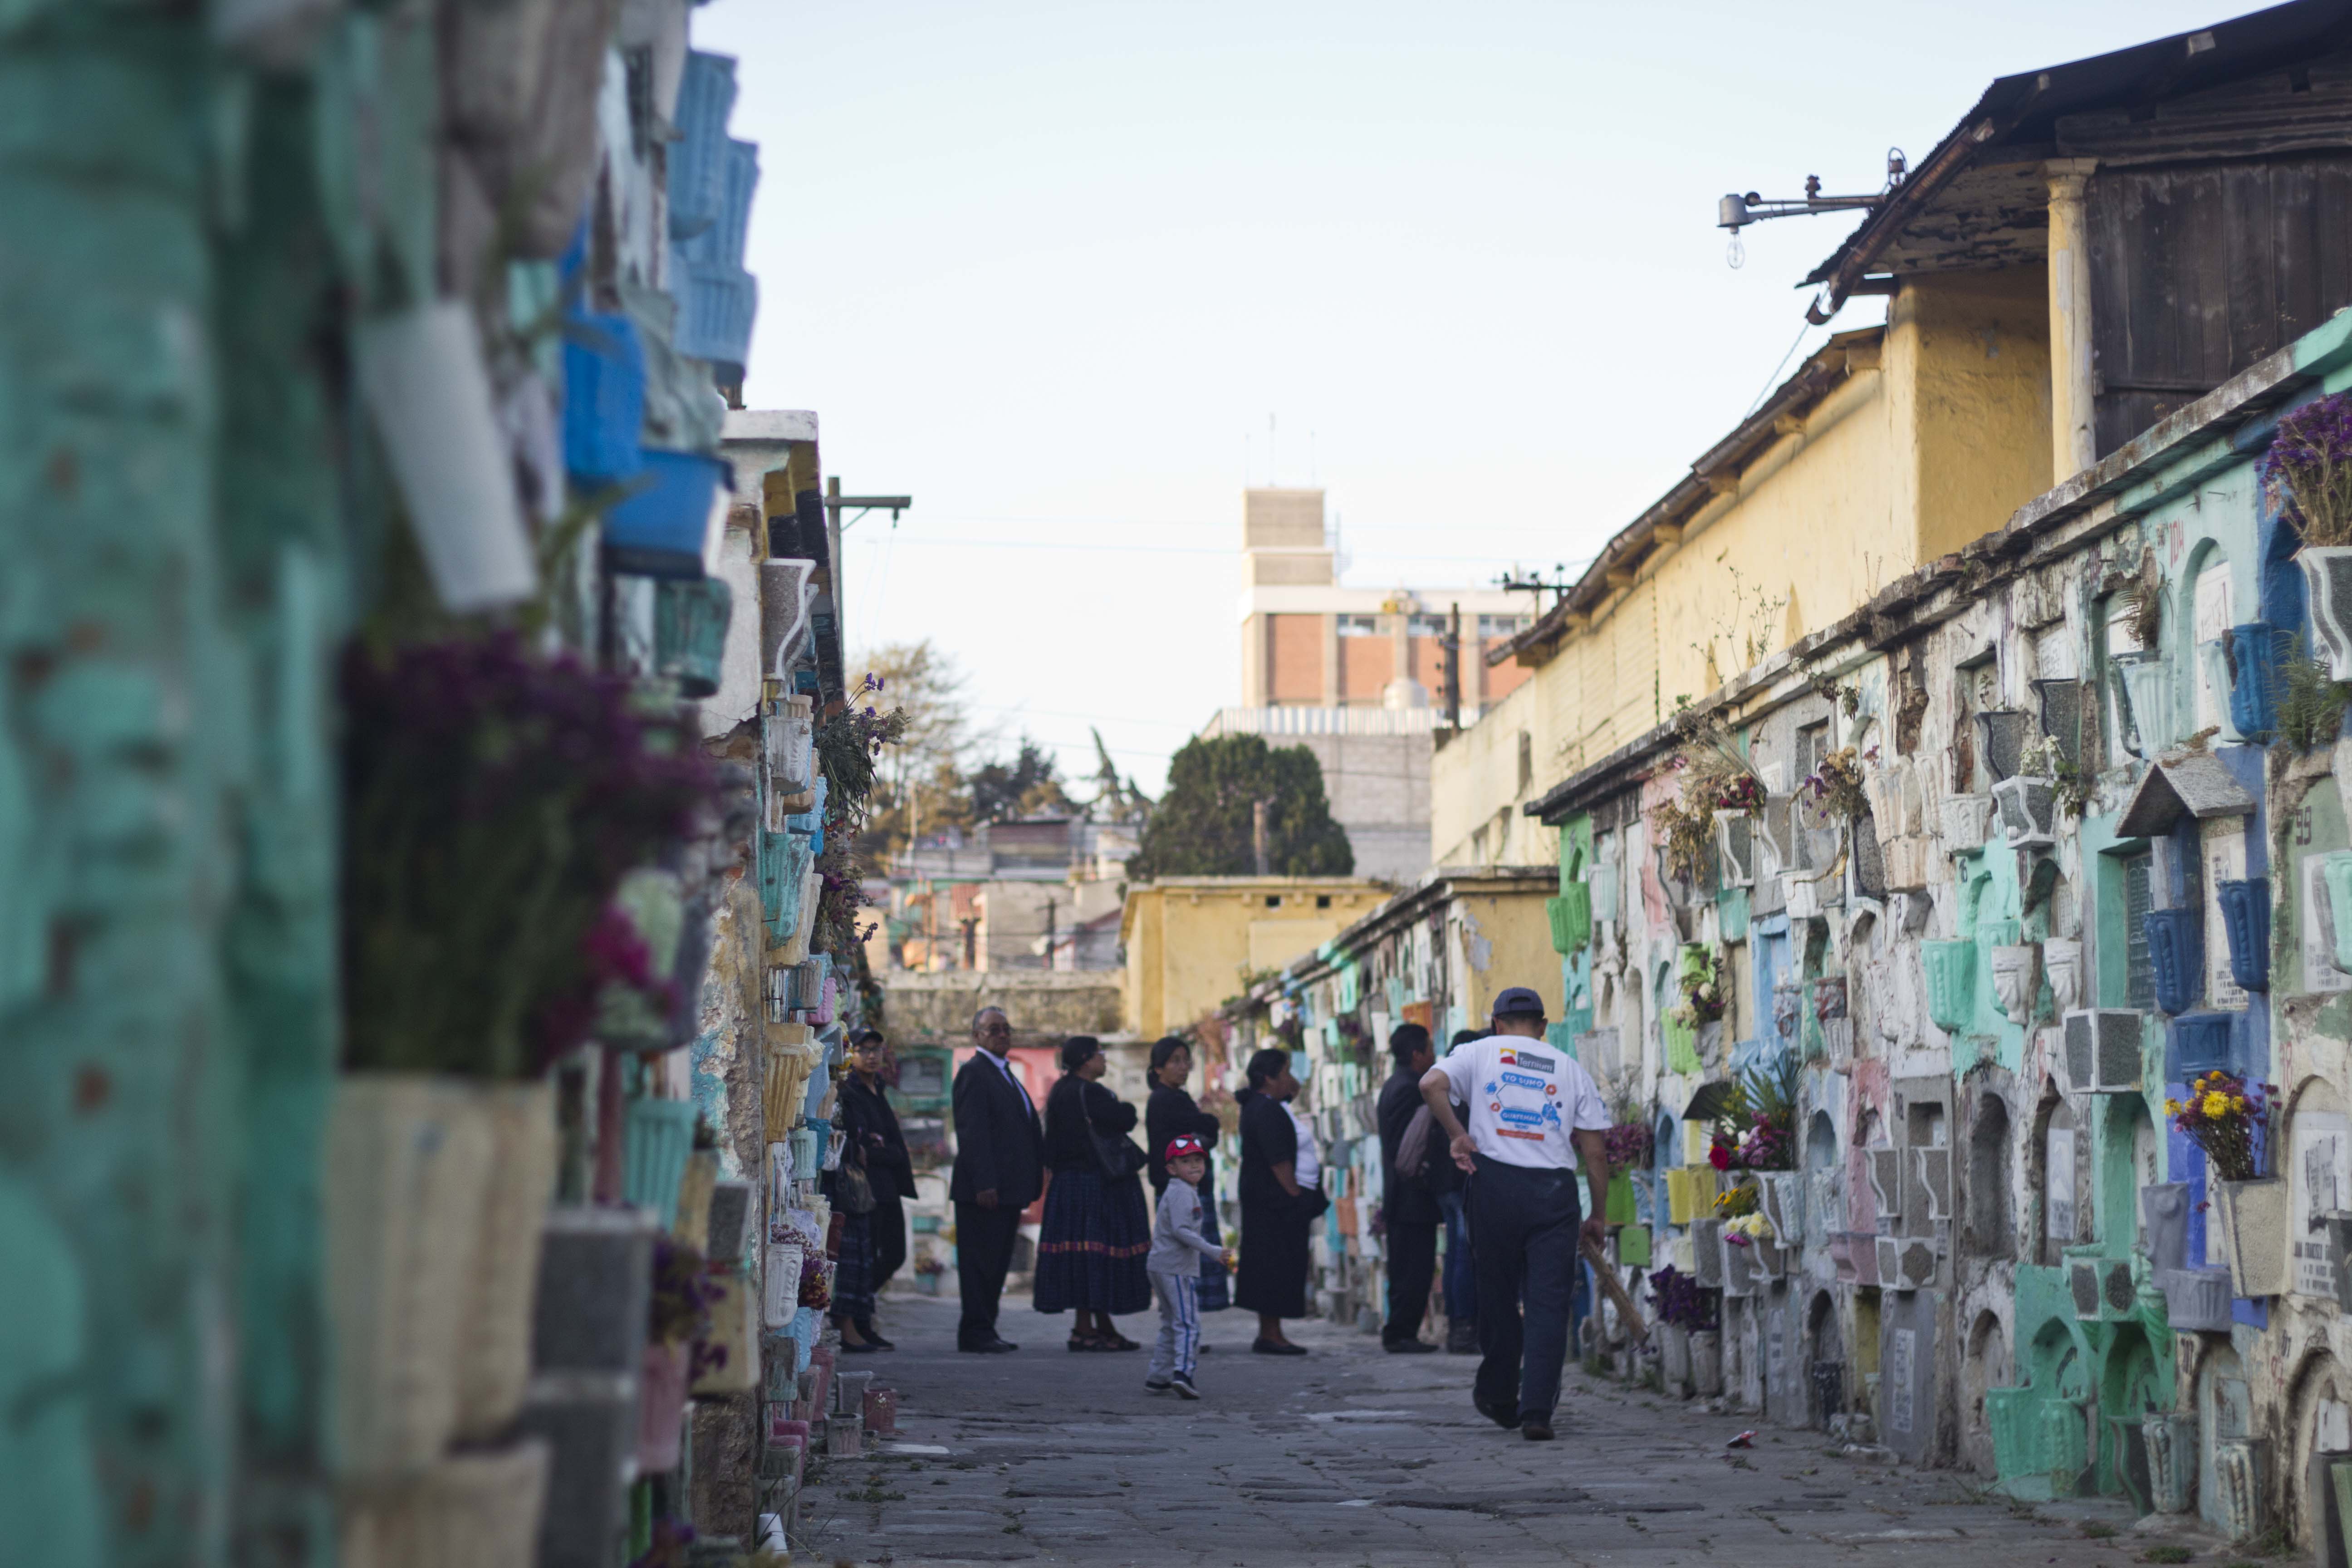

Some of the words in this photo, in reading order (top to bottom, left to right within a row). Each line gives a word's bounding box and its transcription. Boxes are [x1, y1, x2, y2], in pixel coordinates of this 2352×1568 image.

[2169, 516, 2185, 569] 104
[2296, 805, 2312, 846] 99
[1519, 1057, 1553, 1071] Ternium
[1504, 1073, 1517, 1083] YO
[1519, 1077, 1543, 1087] SUMO
[1502, 1112, 1541, 1122] GUATEMALA
